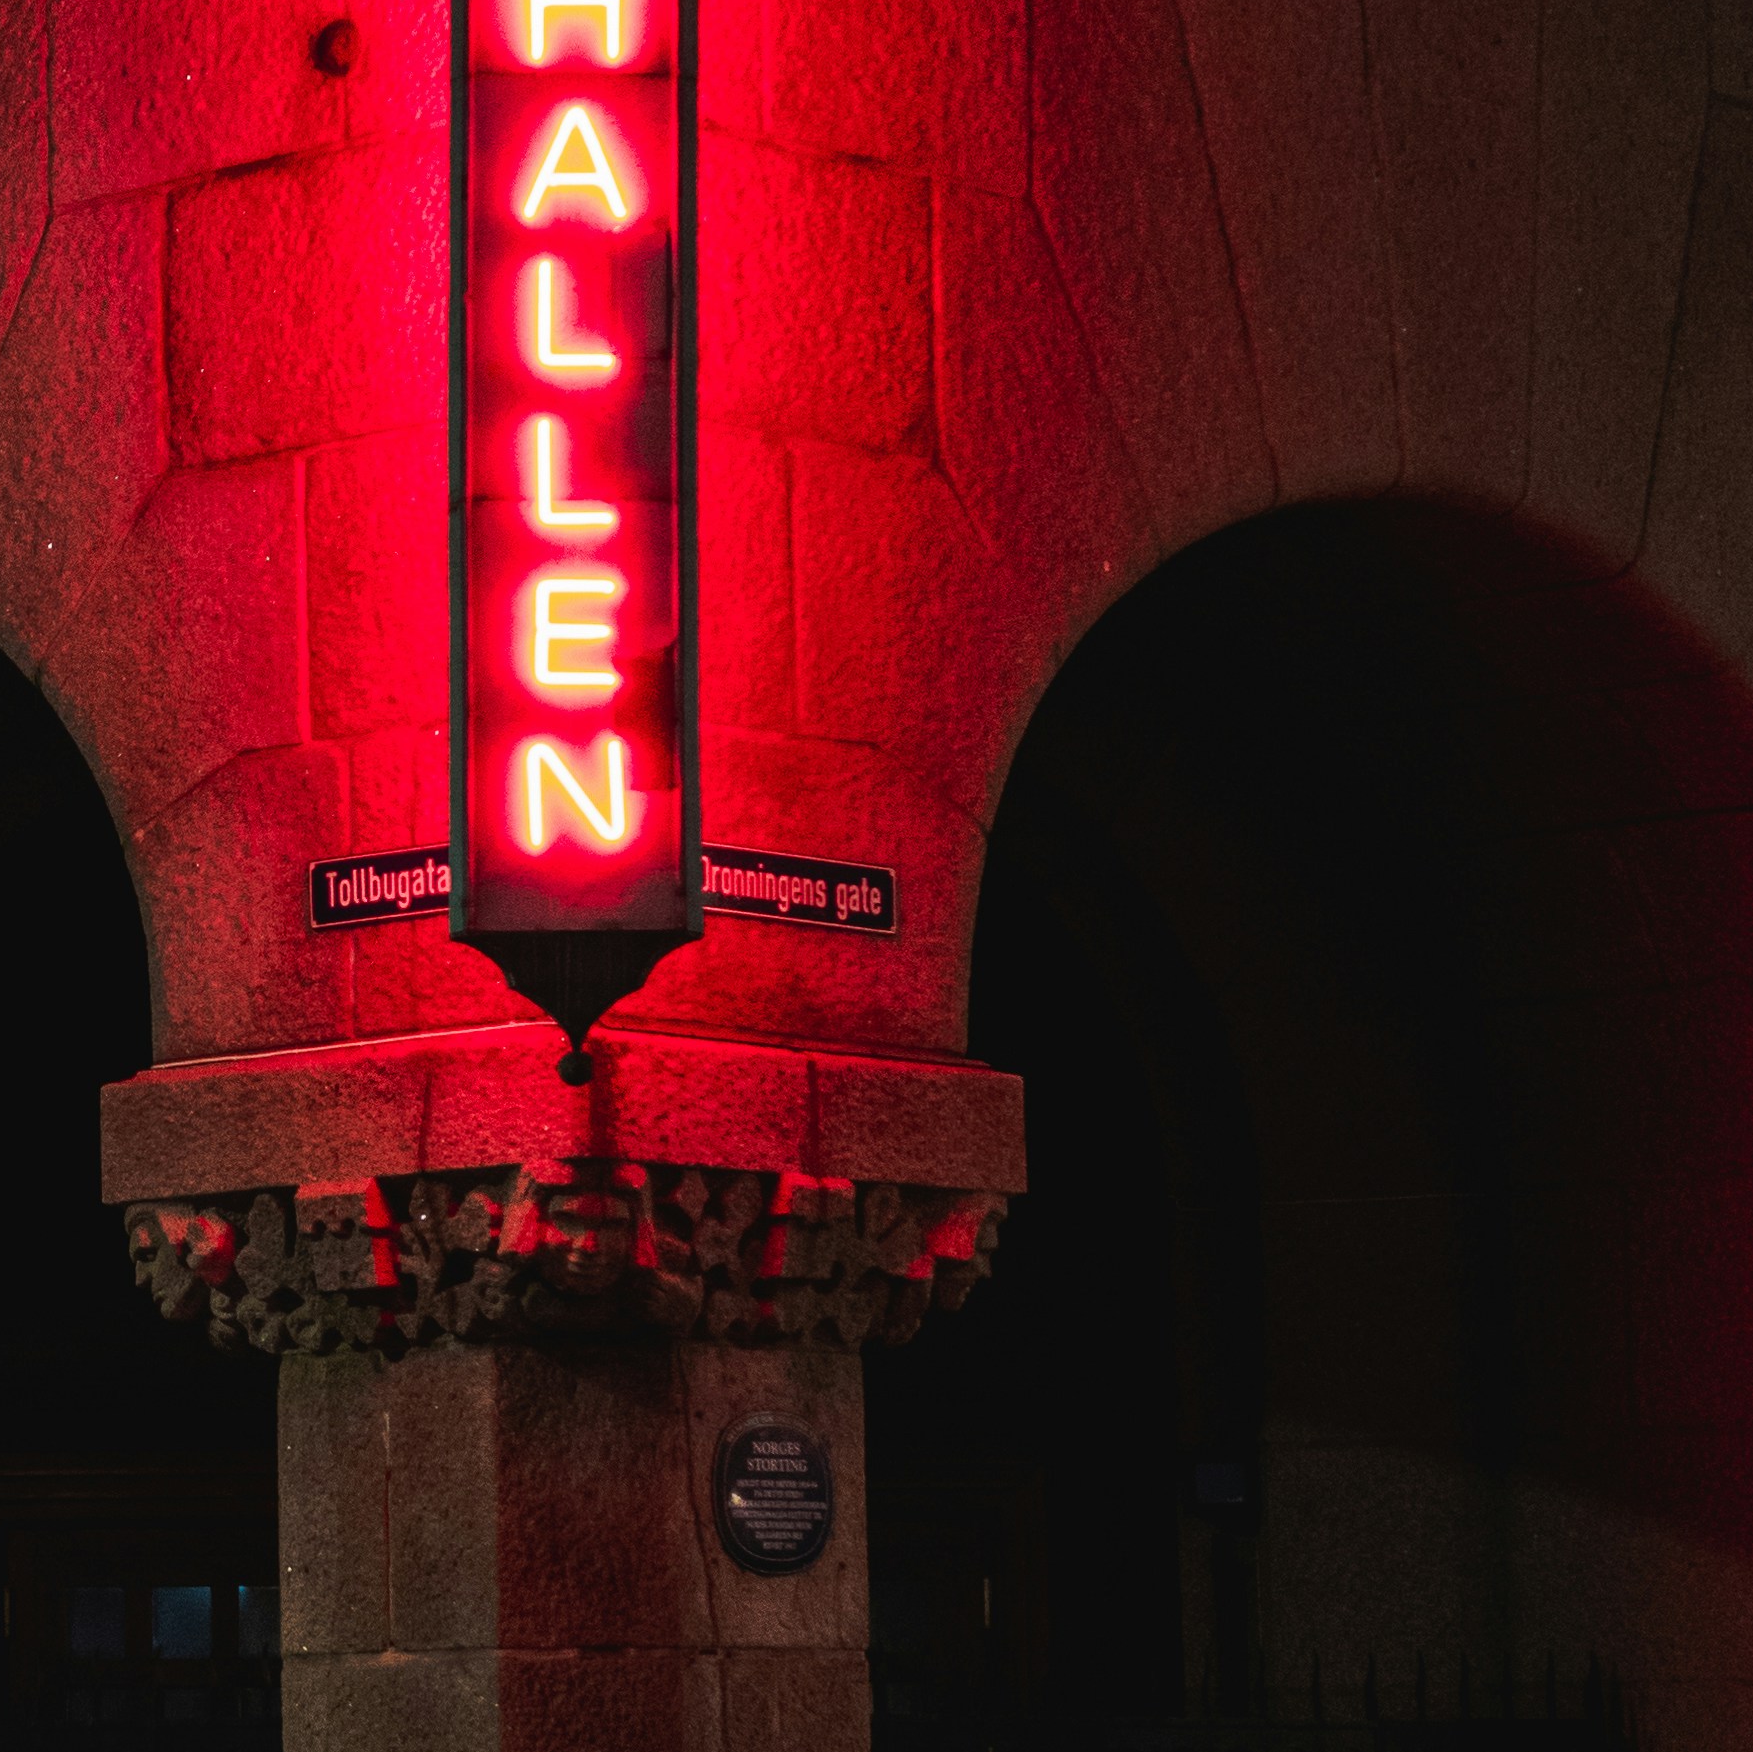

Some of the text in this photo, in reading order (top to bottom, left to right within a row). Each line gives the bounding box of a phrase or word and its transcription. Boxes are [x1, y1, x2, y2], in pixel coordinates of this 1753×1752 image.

[325, 857, 452, 910] Tollbugata
[836, 877, 882, 921] gate
[752, 1441, 802, 1456] NORGES
[746, 1458, 809, 1473] STORTING
